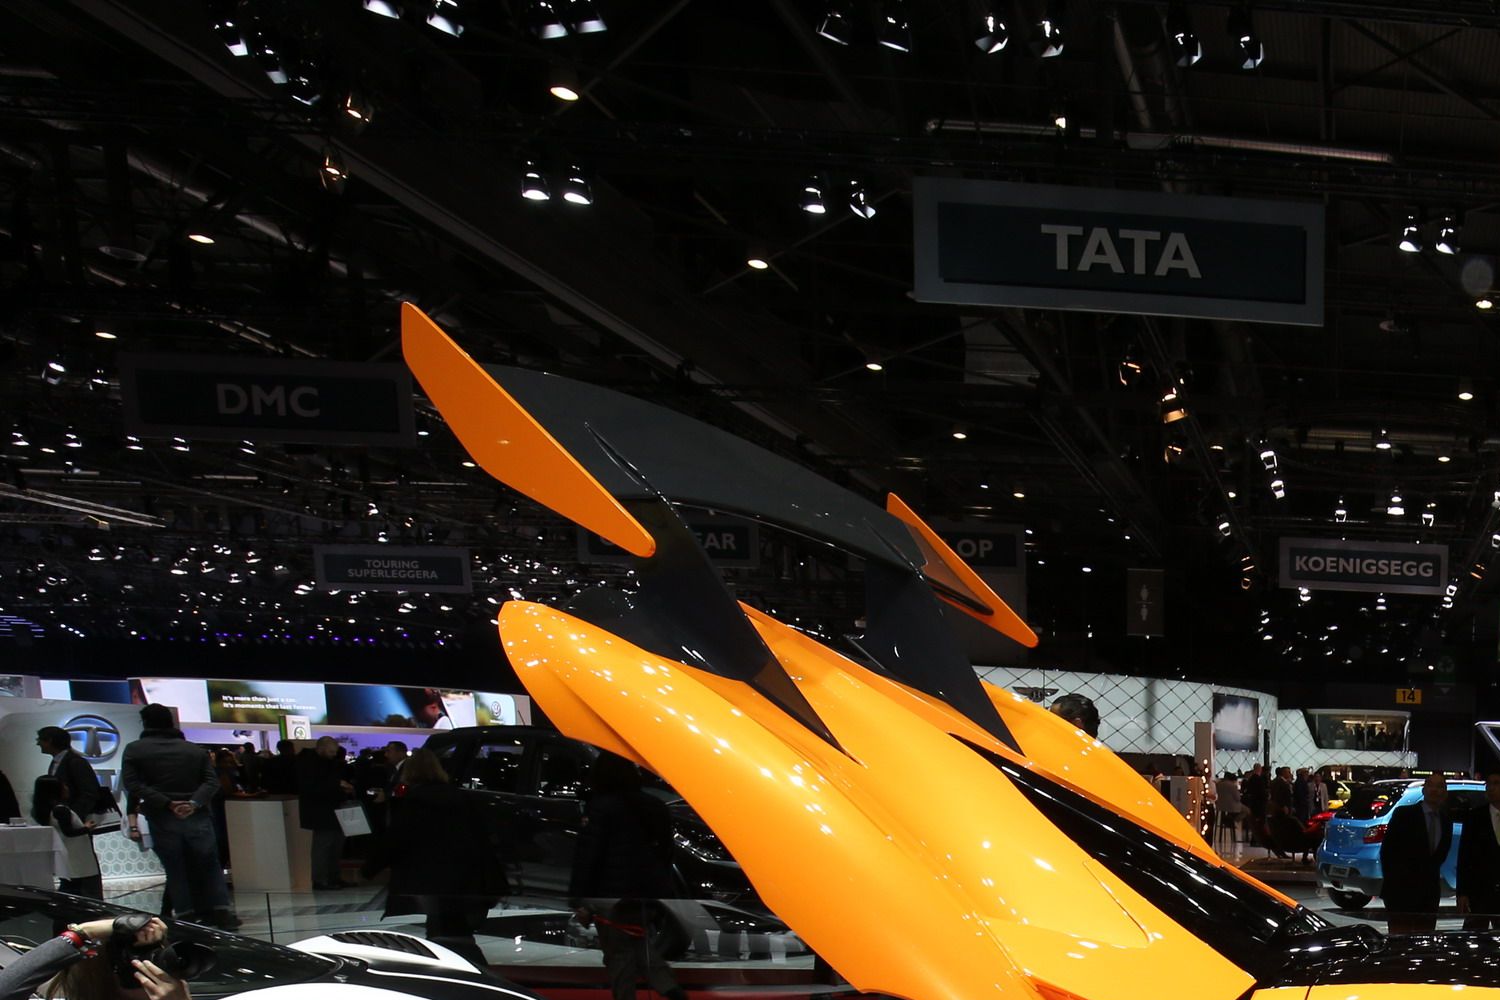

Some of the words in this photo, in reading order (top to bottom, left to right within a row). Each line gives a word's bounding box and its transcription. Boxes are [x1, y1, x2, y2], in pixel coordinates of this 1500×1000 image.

[1040, 223, 1202, 279] TATA
[215, 382, 321, 418] DMC
[364, 559, 420, 569] TOURING
[1295, 555, 1434, 578] KOENIGSEGG
[347, 568, 438, 579] SUPERLEGGERA
[1402, 690, 1416, 702] 14
